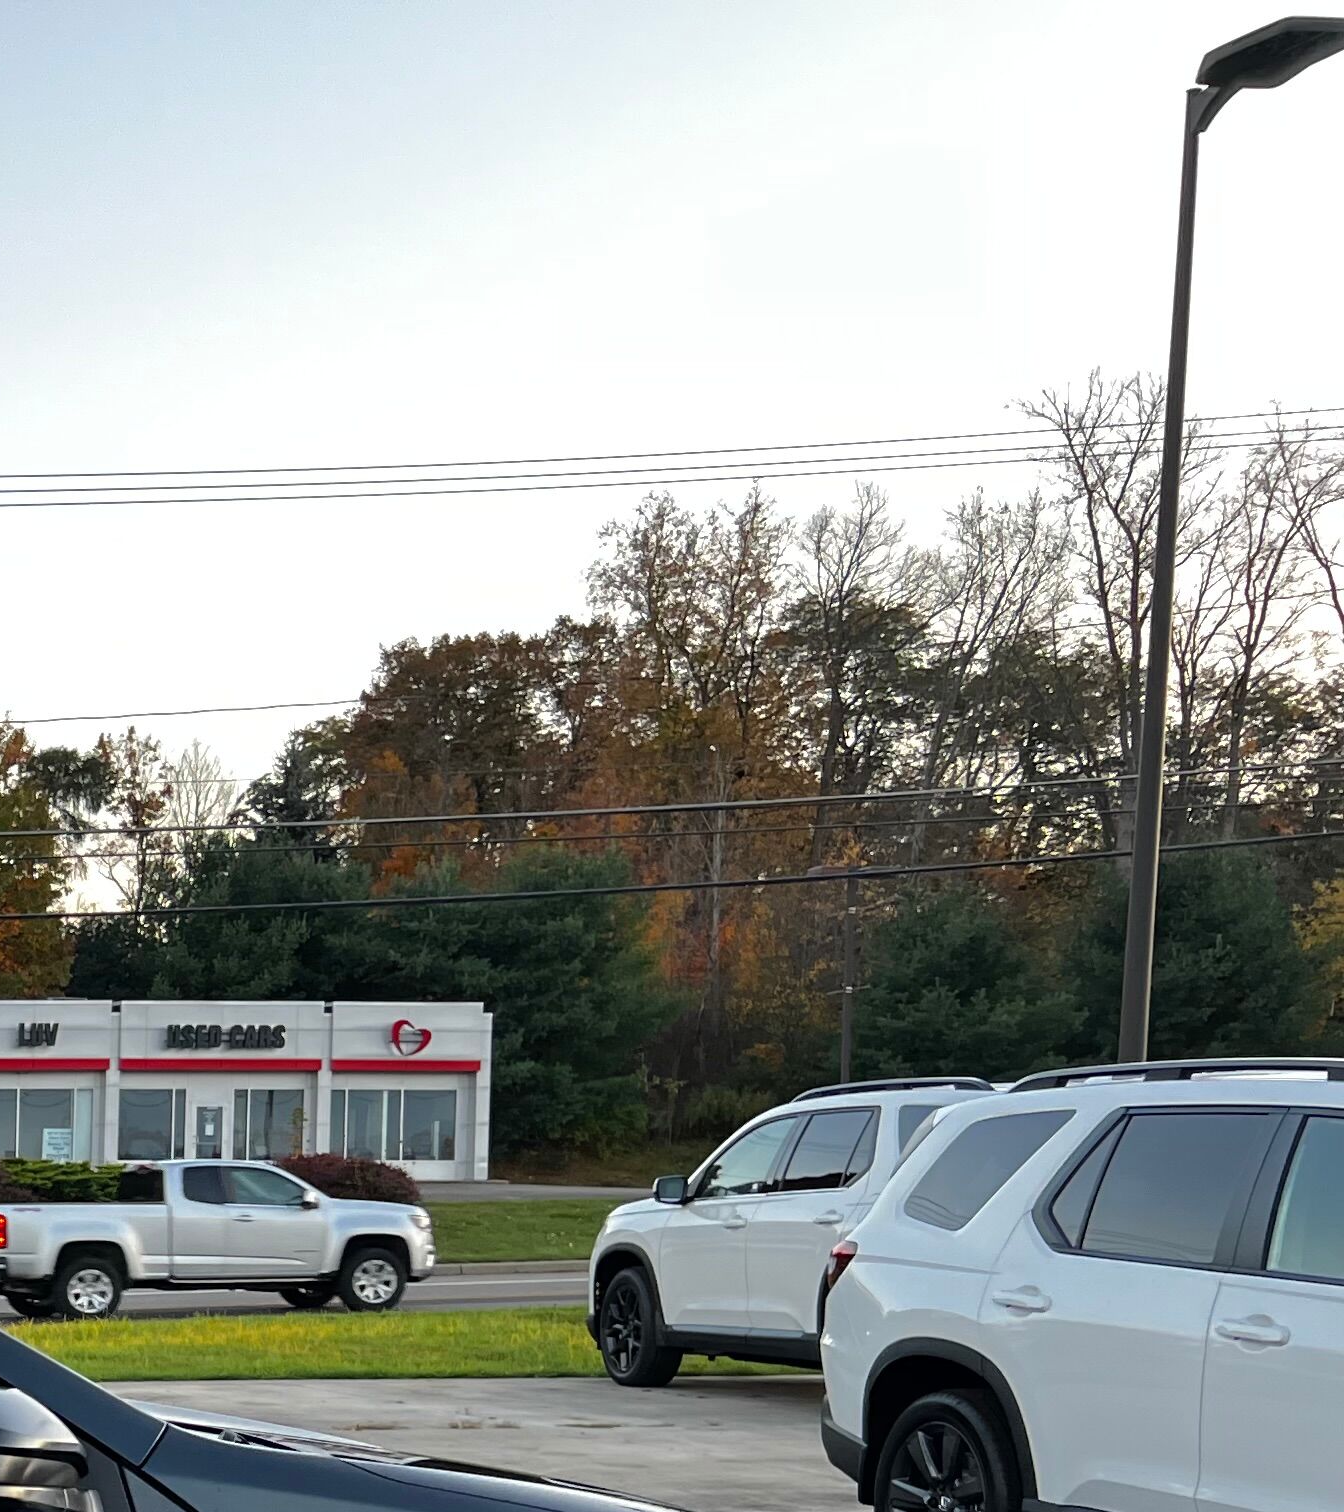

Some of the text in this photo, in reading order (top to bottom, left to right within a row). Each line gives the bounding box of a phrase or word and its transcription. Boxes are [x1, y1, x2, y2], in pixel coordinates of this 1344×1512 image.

[18, 1023, 59, 1047] LUV
[166, 1024, 286, 1048] USED CARS
